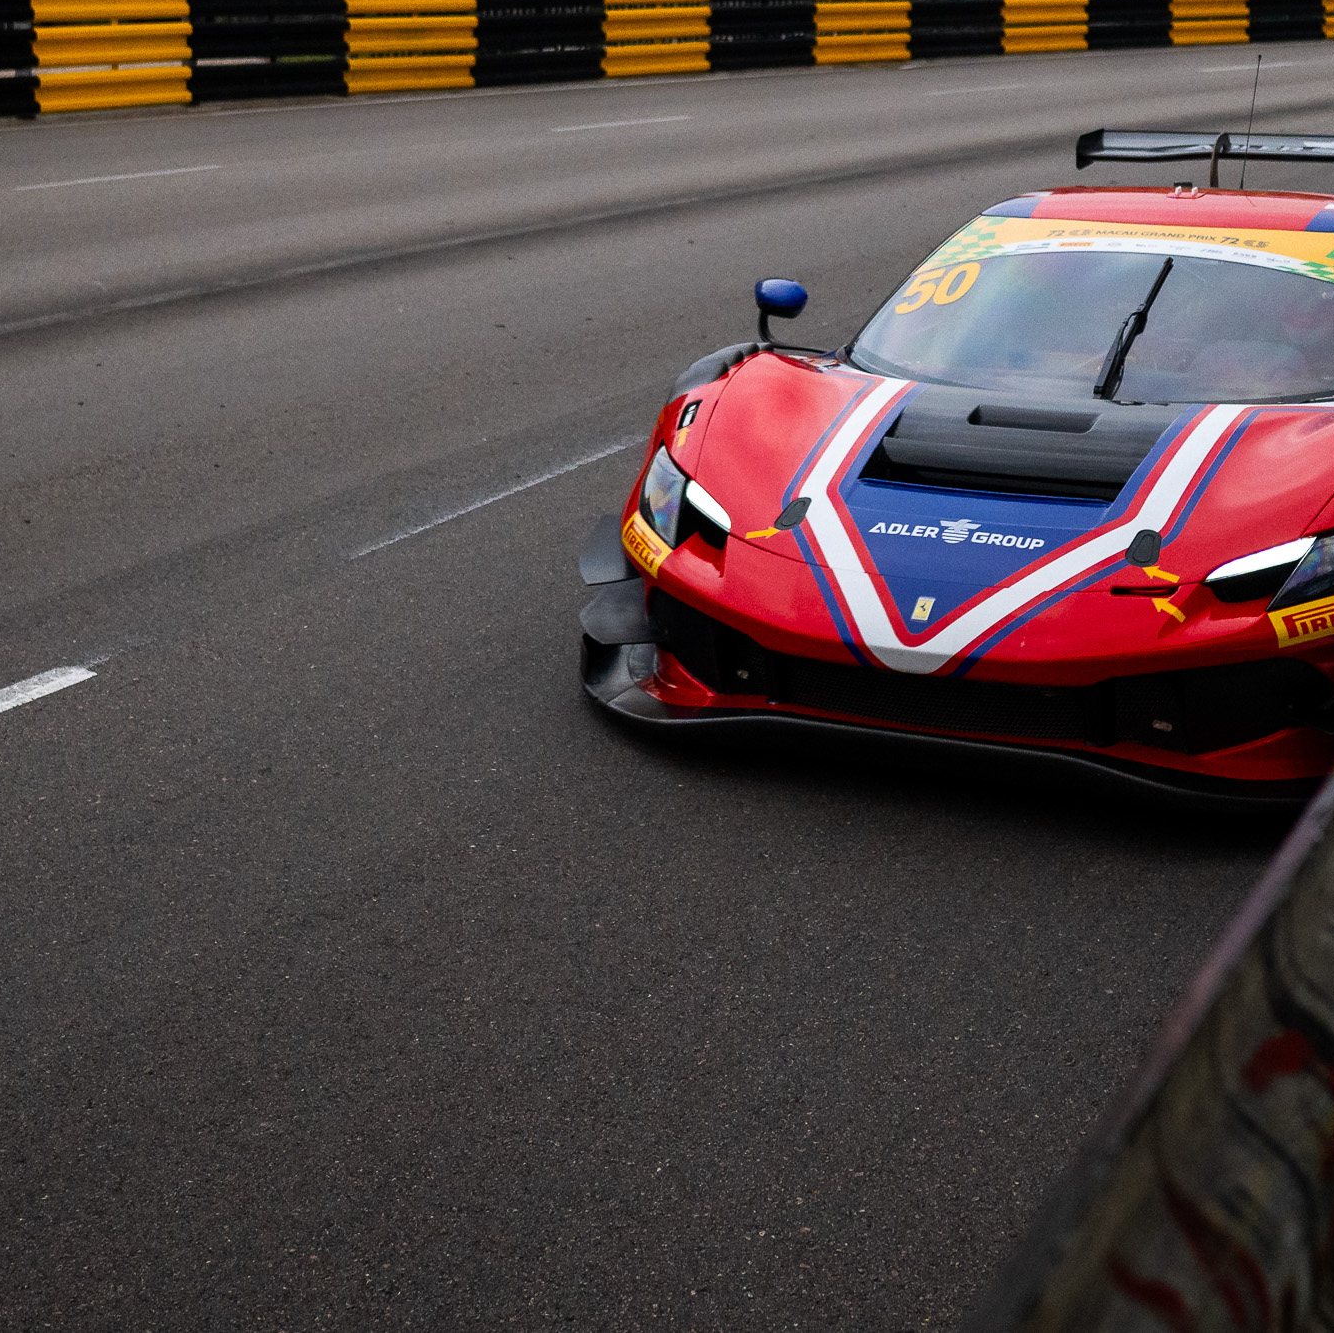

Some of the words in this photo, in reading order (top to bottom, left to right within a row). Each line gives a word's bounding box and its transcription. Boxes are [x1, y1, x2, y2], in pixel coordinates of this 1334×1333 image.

[1189, 234, 1217, 242] PRIX
[1220, 235, 1239, 244] 72
[895, 262, 981, 314] 50
[623, 520, 662, 568] PIRELLI
[868, 522, 939, 538] ADLER
[971, 532, 1045, 550] GROUP
